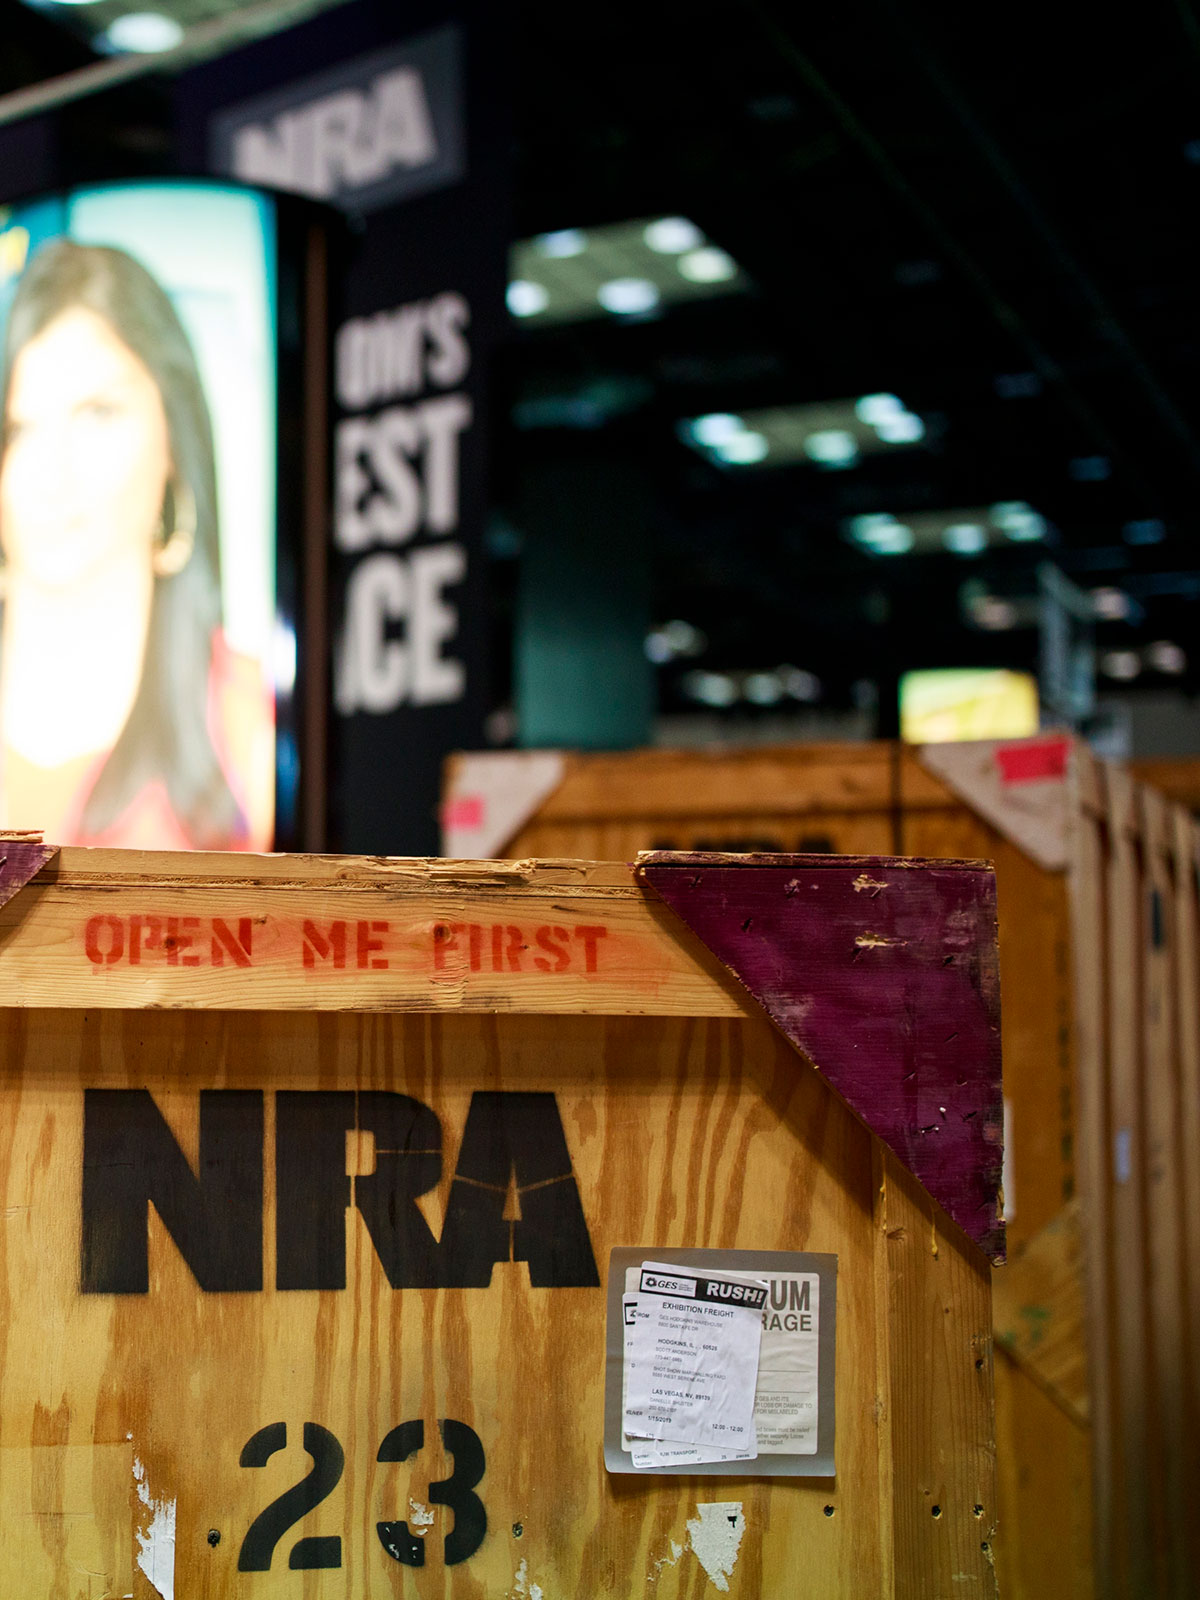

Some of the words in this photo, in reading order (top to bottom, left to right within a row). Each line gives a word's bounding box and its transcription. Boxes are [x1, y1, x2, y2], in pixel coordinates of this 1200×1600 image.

[232, 65, 439, 197] NRA
[84, 913, 253, 968] OPEN
[302, 920, 390, 970] ME
[432, 922, 608, 974] FIRST
[79, 1088, 601, 1294] NRA
[658, 1280, 678, 1290] GES
[706, 1281, 764, 1303] RUSH!
[662, 1302, 703, 1314] EXHIBITION
[704, 1308, 735, 1318] FREIGHT
[763, 1279, 810, 1311] UM
[237, 1418, 488, 1572] 23
